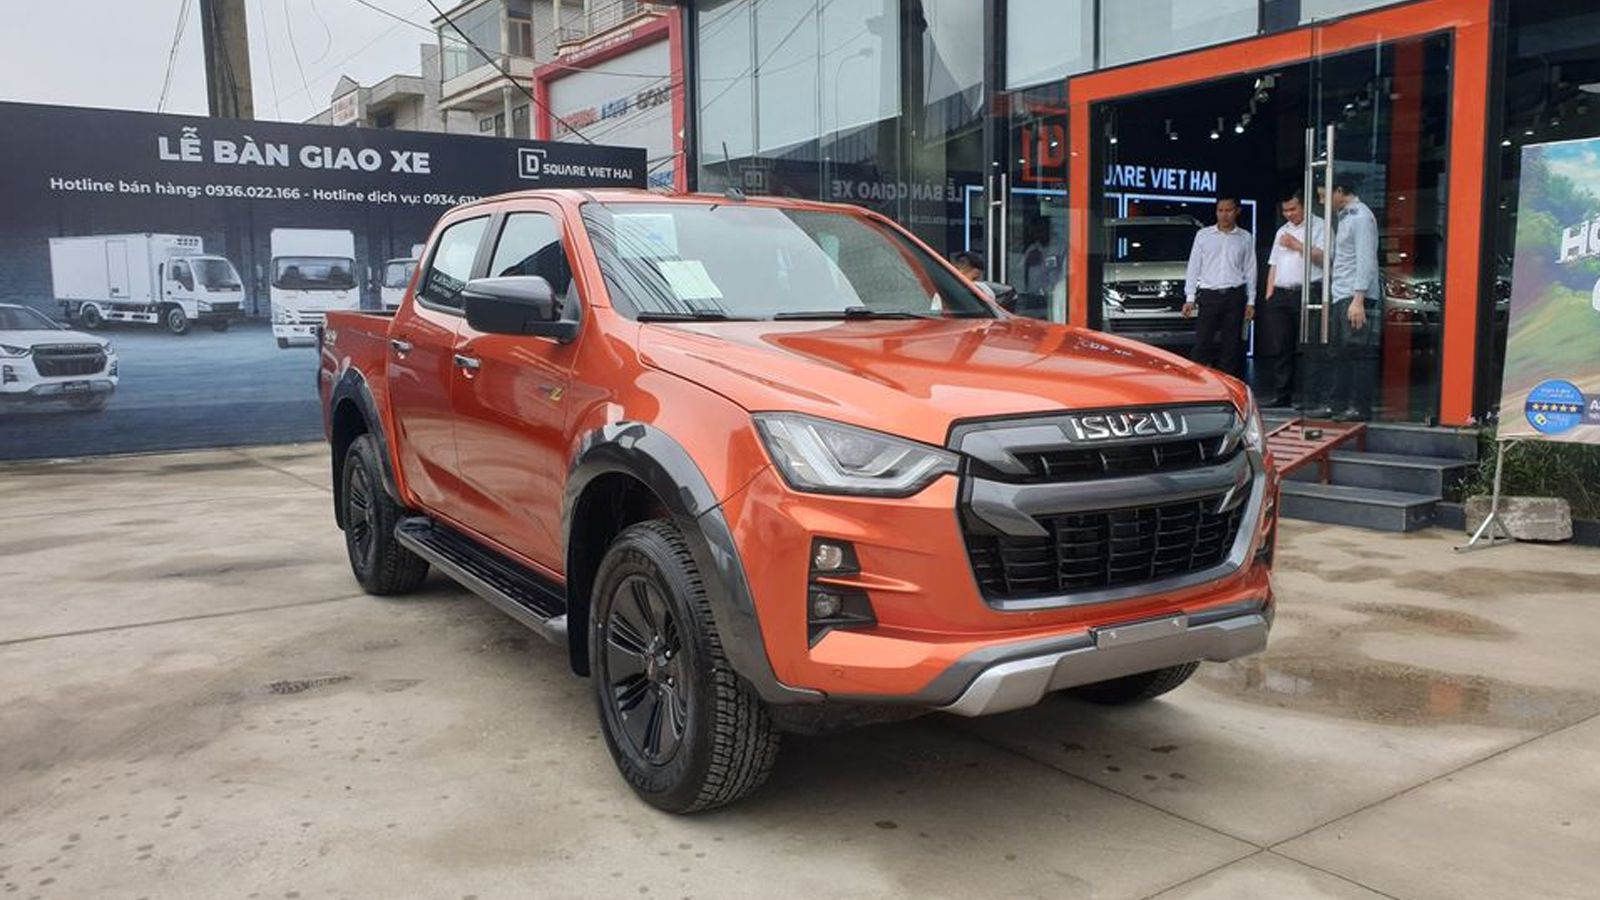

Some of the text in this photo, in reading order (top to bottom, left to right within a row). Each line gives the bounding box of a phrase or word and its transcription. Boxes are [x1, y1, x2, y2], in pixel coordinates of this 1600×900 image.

[158, 126, 431, 174] LỄ BÀN GIAO XE
[543, 163, 586, 177] SQUARE
[587, 166, 612, 178] VIET
[612, 168, 633, 179] HAI
[1149, 167, 1187, 190] VIET
[1189, 170, 1217, 192] HAI
[50, 177, 114, 192] Hotline
[119, 180, 151, 194] bán
[155, 181, 202, 198] hàng:
[204, 183, 301, 200] 0936.022.166
[313, 189, 365, 203] Hotline
[367, 189, 397, 205] dịch
[1070, 411, 1176, 439] ISUZU
